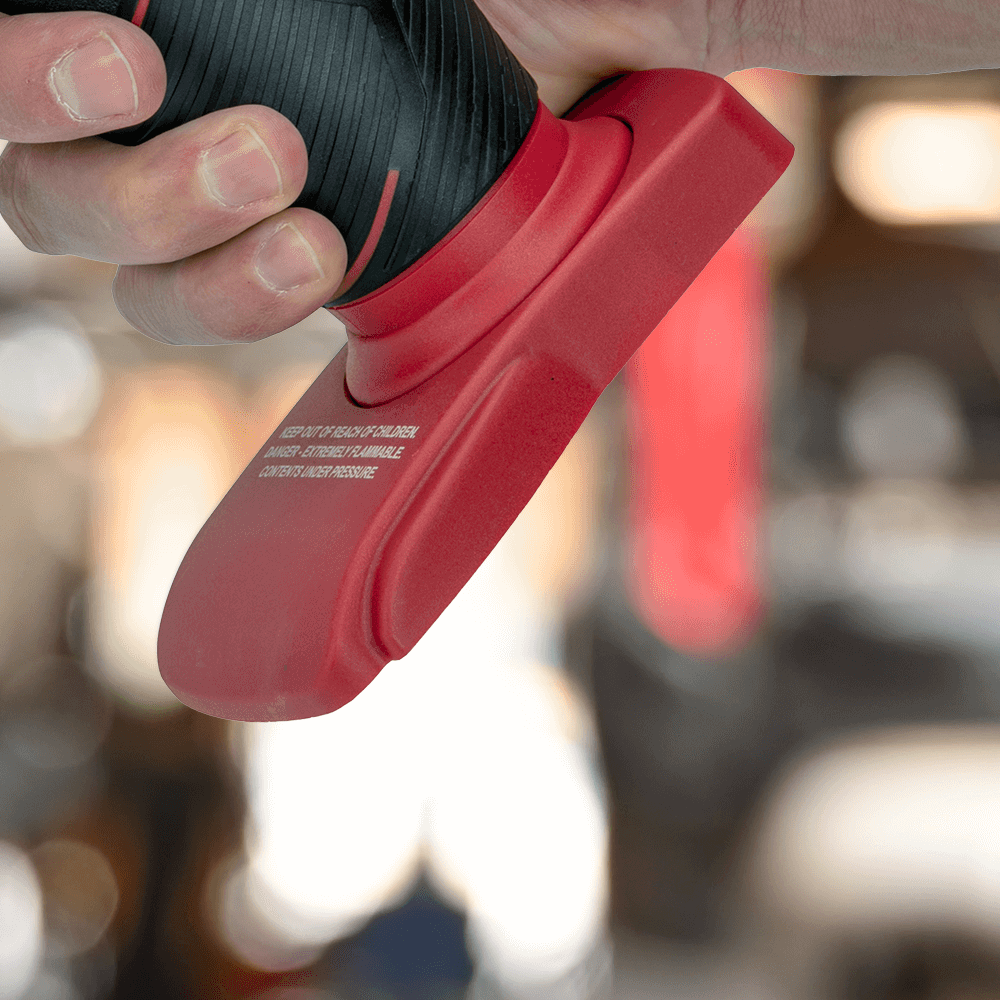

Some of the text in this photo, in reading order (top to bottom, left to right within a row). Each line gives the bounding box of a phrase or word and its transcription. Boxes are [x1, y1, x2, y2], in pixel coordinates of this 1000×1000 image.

[279, 425, 419, 438] KEEP OUT OF REACH OF CHILDREN.
[264, 446, 300, 458] DANGER
[301, 446, 354, 458] EXTREMELY
[259, 465, 304, 477] CONTENTS
[301, 465, 333, 478] UNDER
